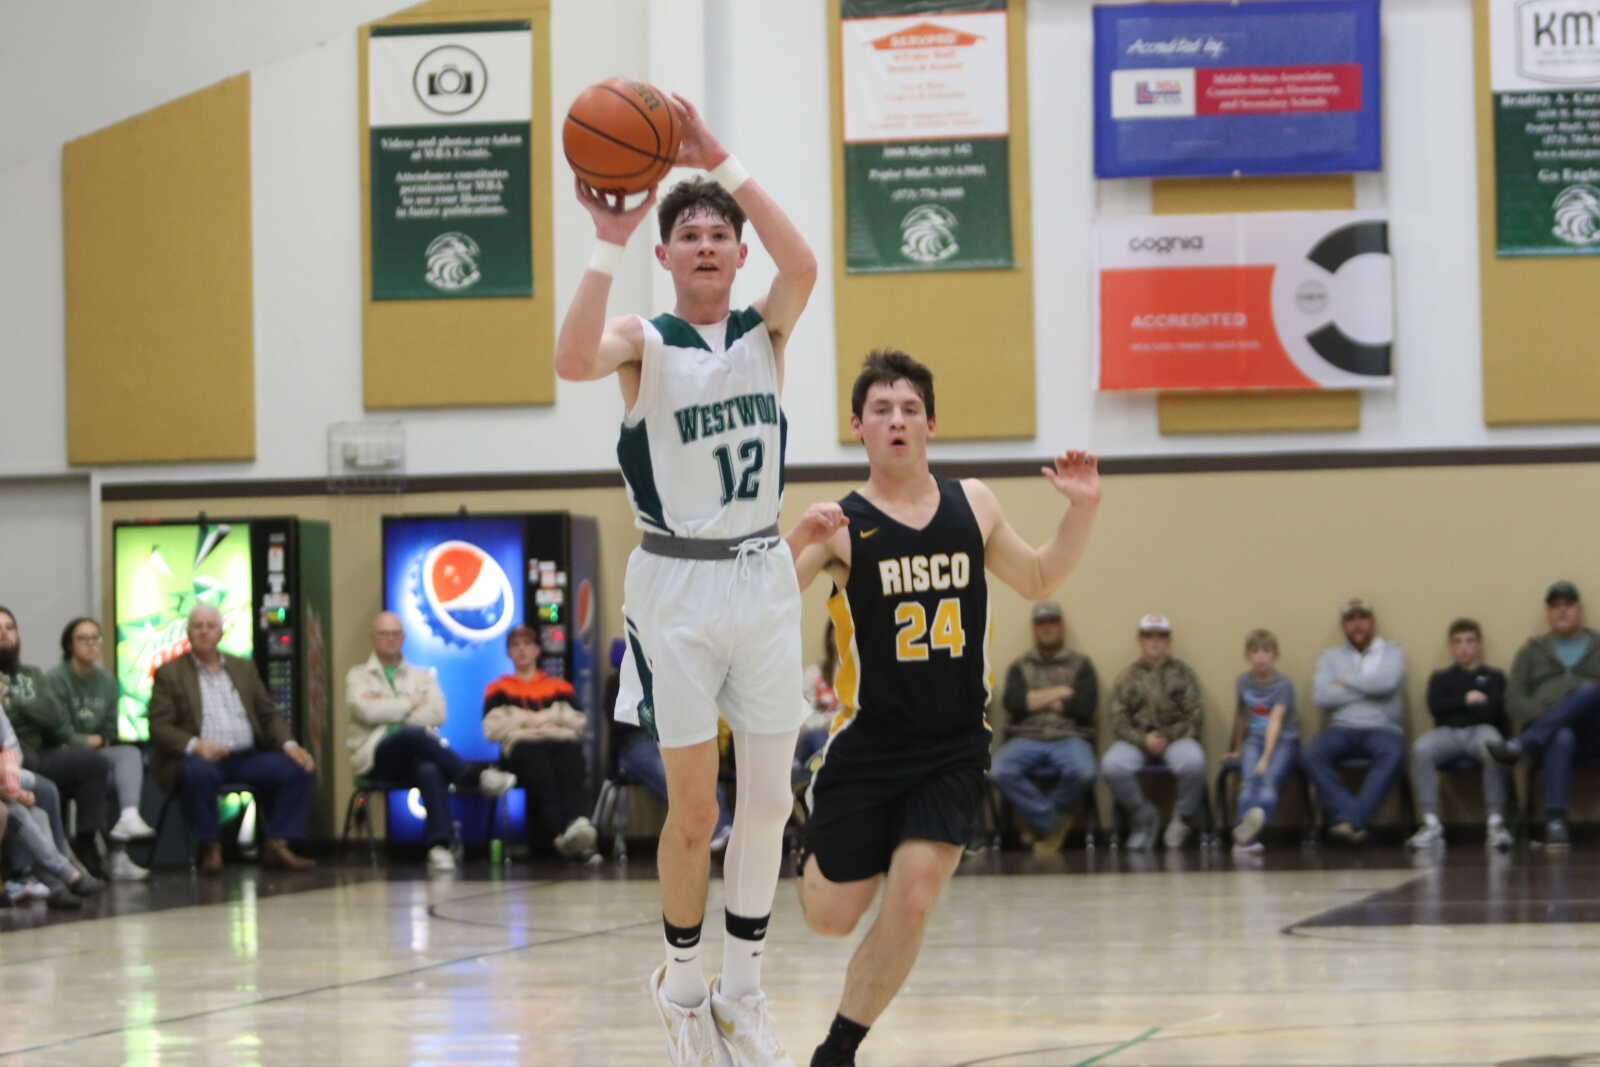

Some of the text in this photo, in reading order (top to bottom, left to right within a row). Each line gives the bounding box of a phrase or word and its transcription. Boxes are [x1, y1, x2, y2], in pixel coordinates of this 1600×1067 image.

[1534, 11, 1600, 46] KM
[1126, 37, 1225, 58] Accredited by
[1128, 235, 1204, 254] cognia
[1130, 312, 1248, 328] ACCREDITED
[712, 436, 765, 507] 12
[878, 552, 970, 597] RISCO
[895, 597, 966, 662] 24
